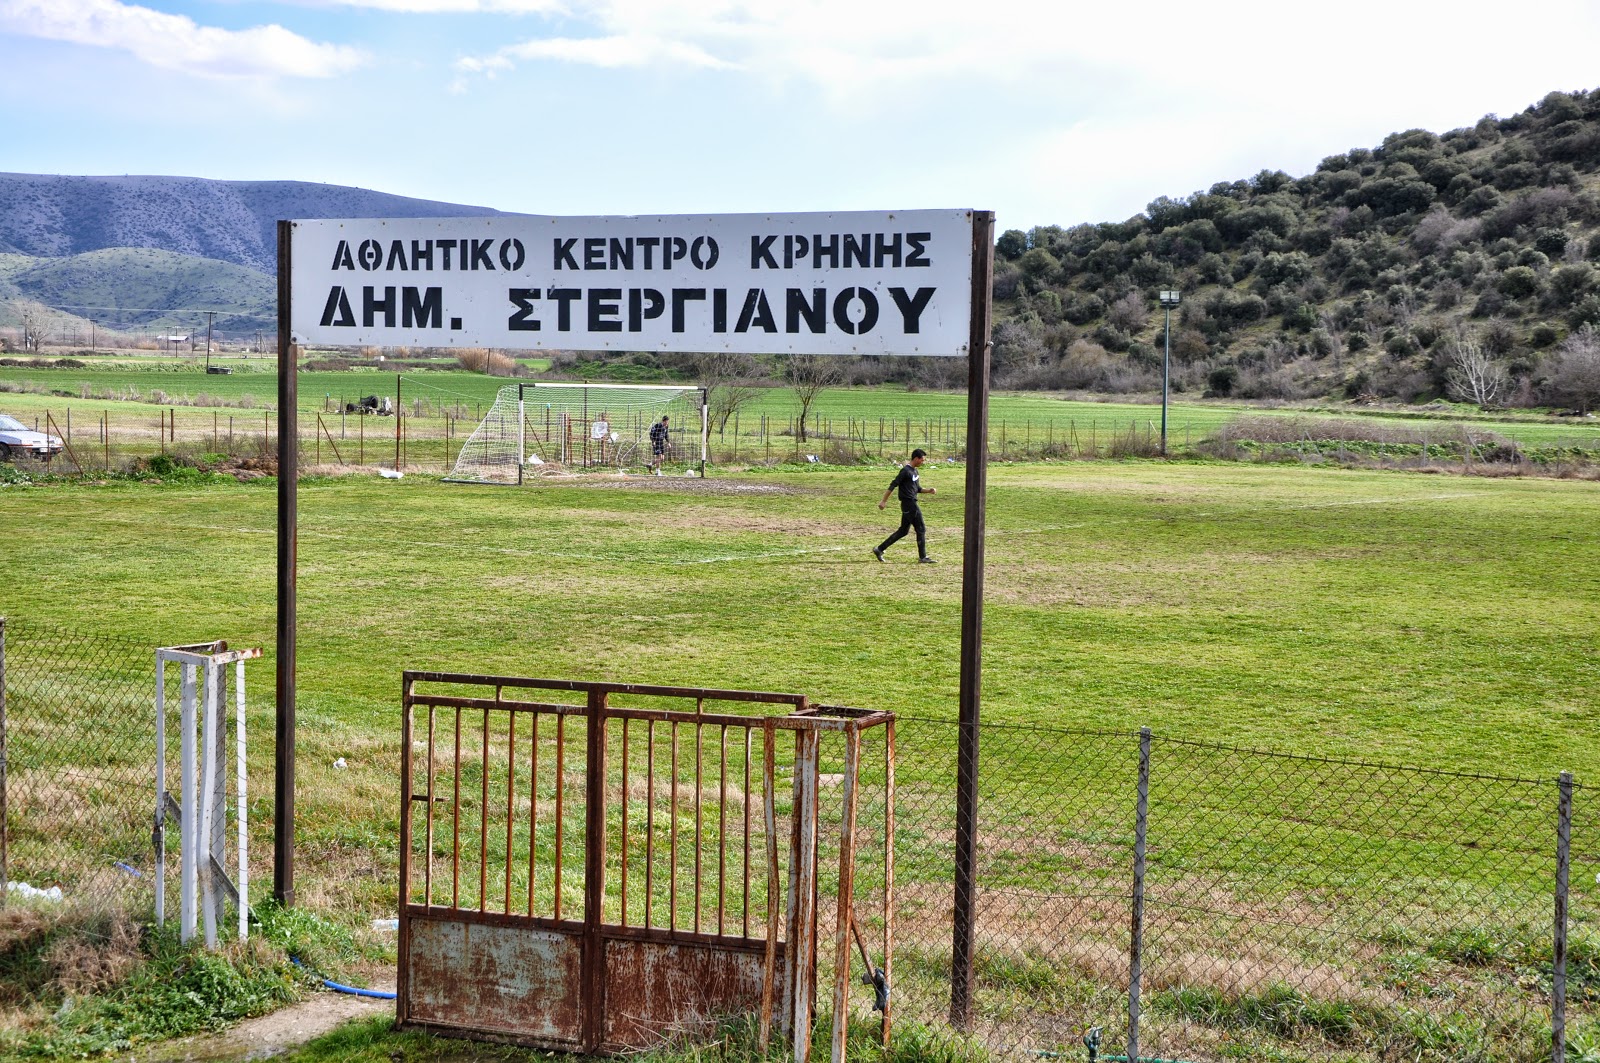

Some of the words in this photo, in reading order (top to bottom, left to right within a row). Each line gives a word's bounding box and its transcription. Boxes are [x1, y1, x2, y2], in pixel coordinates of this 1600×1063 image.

[332, 238, 525, 271] ΑΘΛΗΤΙΚΟ
[554, 236, 719, 270] ΚΕΝΤΡΟ
[751, 232, 932, 269] ΚΡΗΝΗΣ
[320, 286, 462, 331] ΔΗΜ.
[509, 286, 936, 335] ΣΤΕΡΓΙΑΝΟΥ
